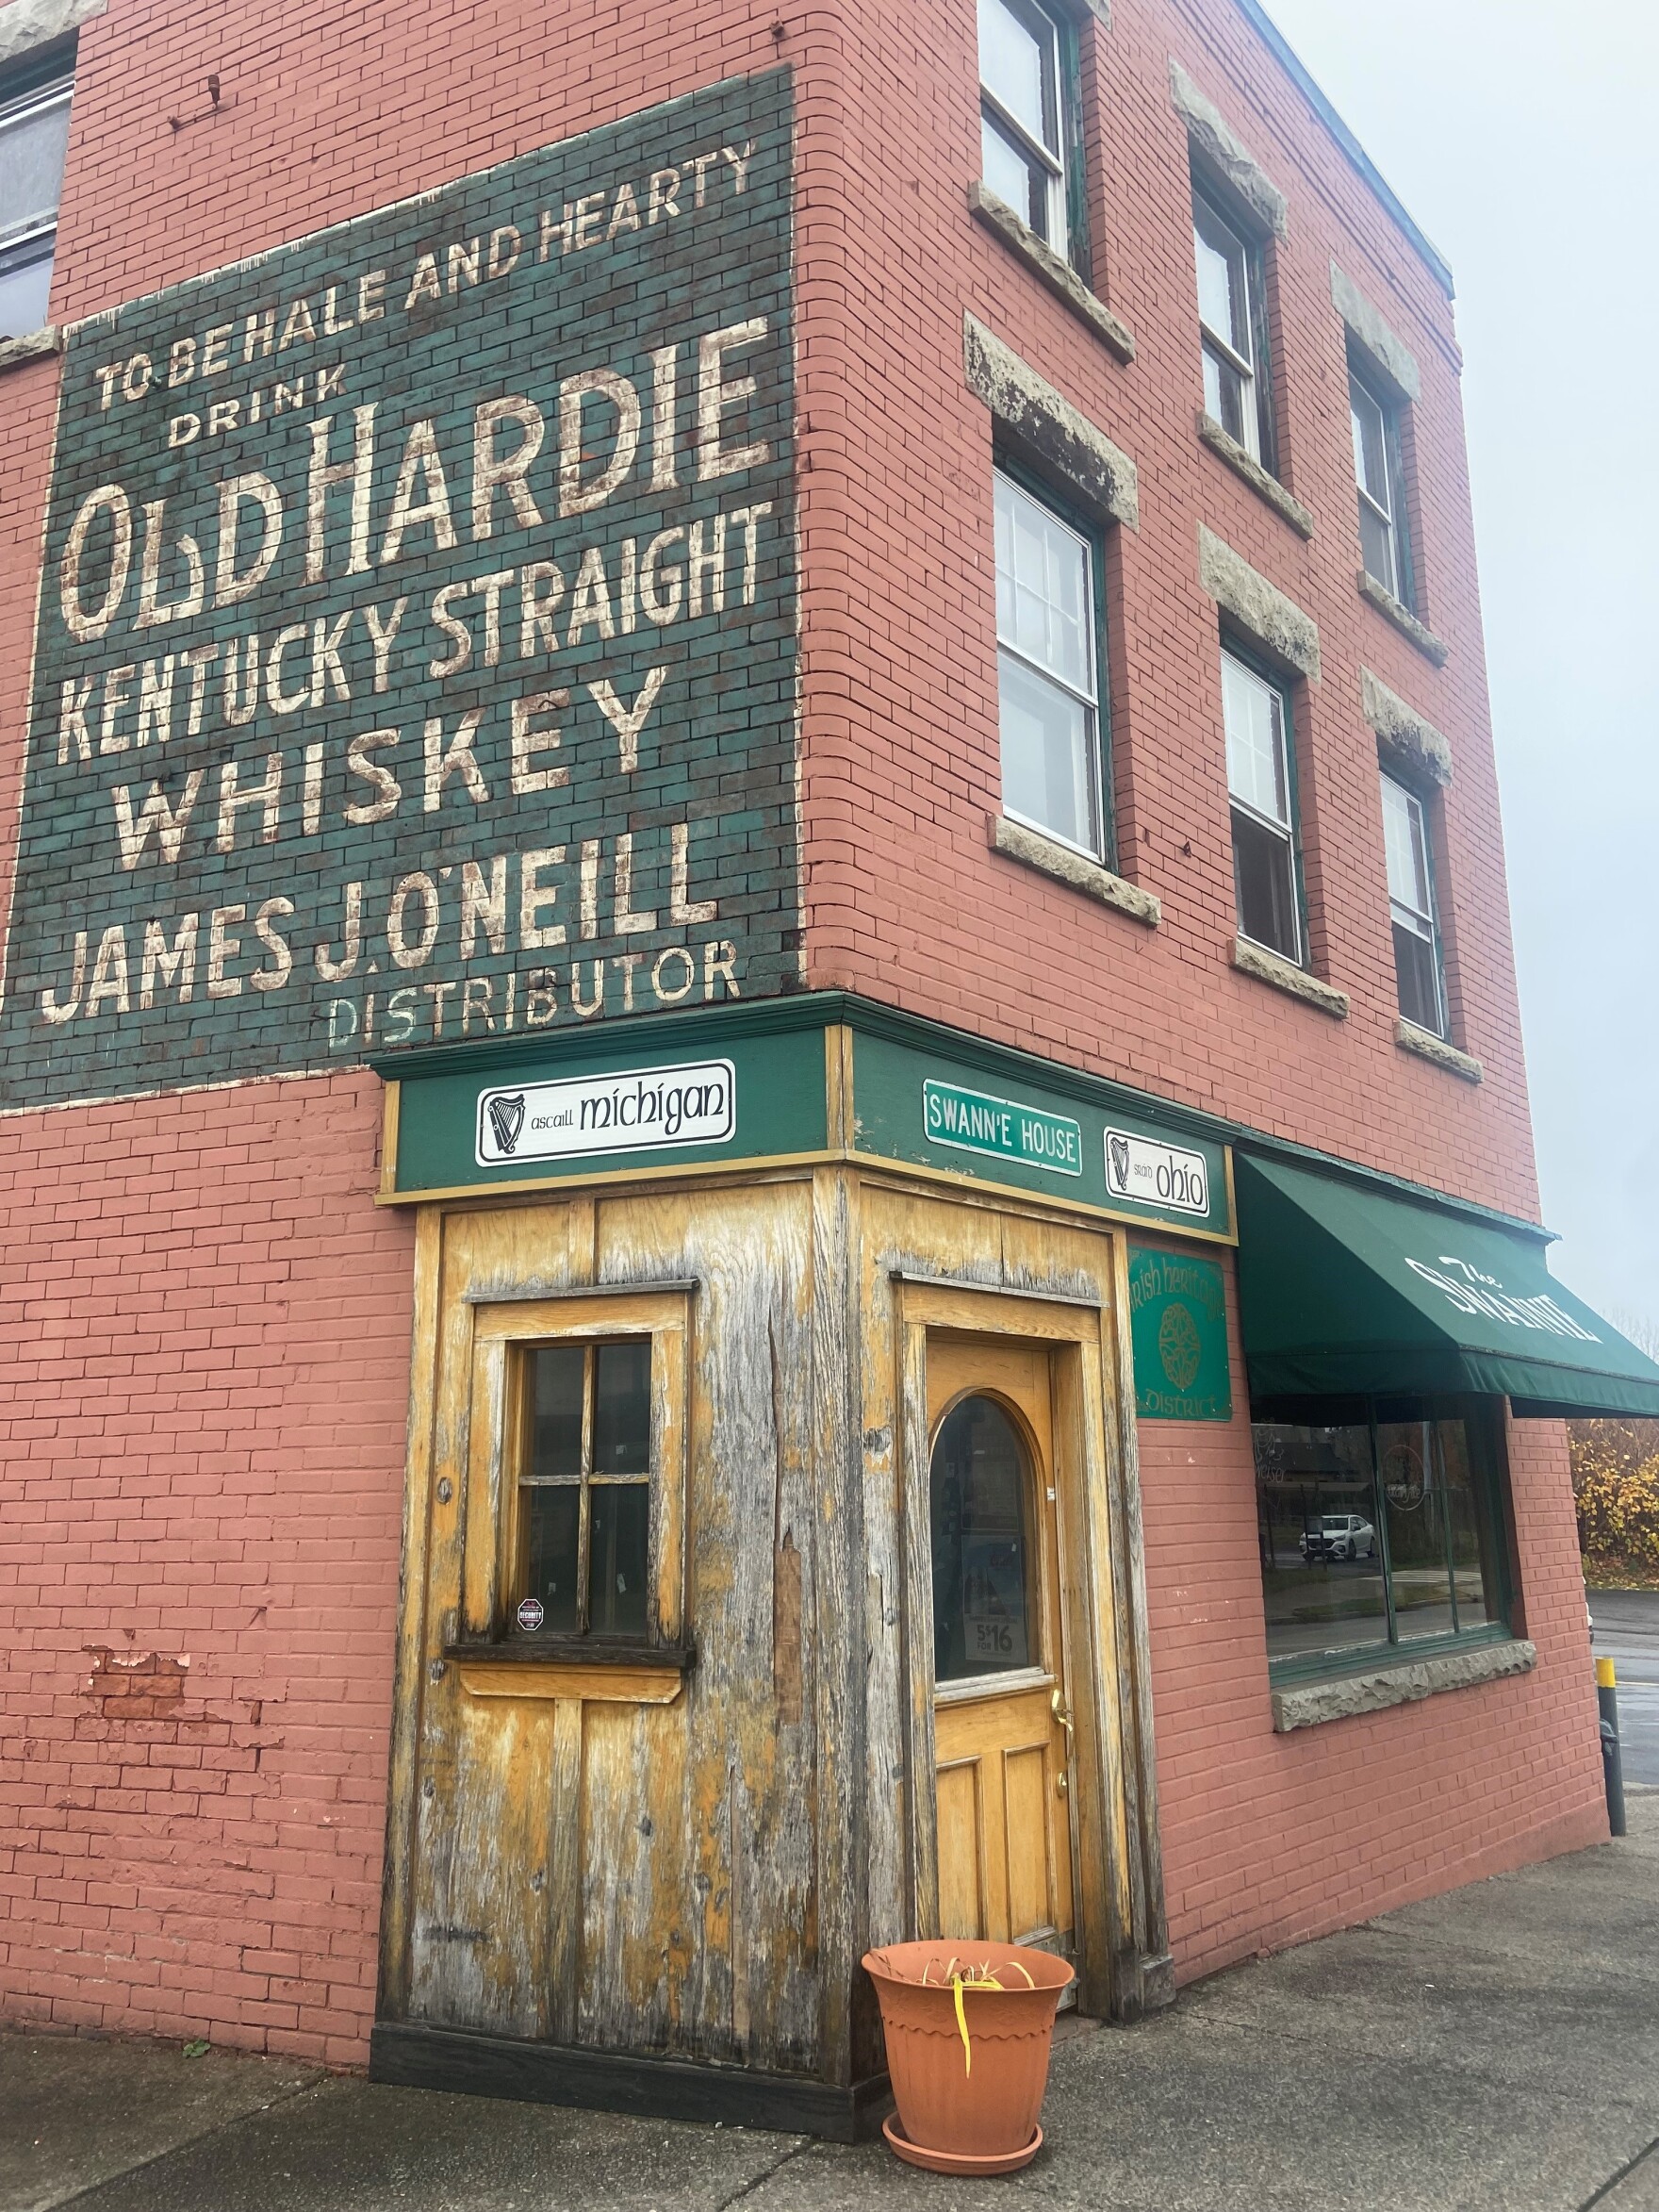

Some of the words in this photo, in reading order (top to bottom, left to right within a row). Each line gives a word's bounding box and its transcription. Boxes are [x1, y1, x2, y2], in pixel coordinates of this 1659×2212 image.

[95, 360, 155, 411] TO
[169, 323, 235, 388] BE
[243, 269, 386, 364] HALE
[403, 225, 522, 311] AND
[539, 141, 753, 262] HEARTY
[167, 362, 348, 449] DRINK
[59, 471, 283, 645] OLD
[305, 316, 770, 587] HARDIE
[56, 596, 409, 765] KENTUCKY
[431, 501, 775, 679] STRAIGHT
[111, 664, 669, 871] WHISKEY
[40, 896, 296, 1025] JAMES
[386, 823, 718, 973] O'NEILL
[327, 939, 742, 1048] DISTRIBUTOR
[531, 1109, 574, 1131] ascaill
[1022, 1118, 1077, 1164] HOUSE
[1404, 1257, 1604, 1345] SWANNIE
[1438, 1256, 1503, 1289] The
[977, 1641, 992, 1651] FOR
